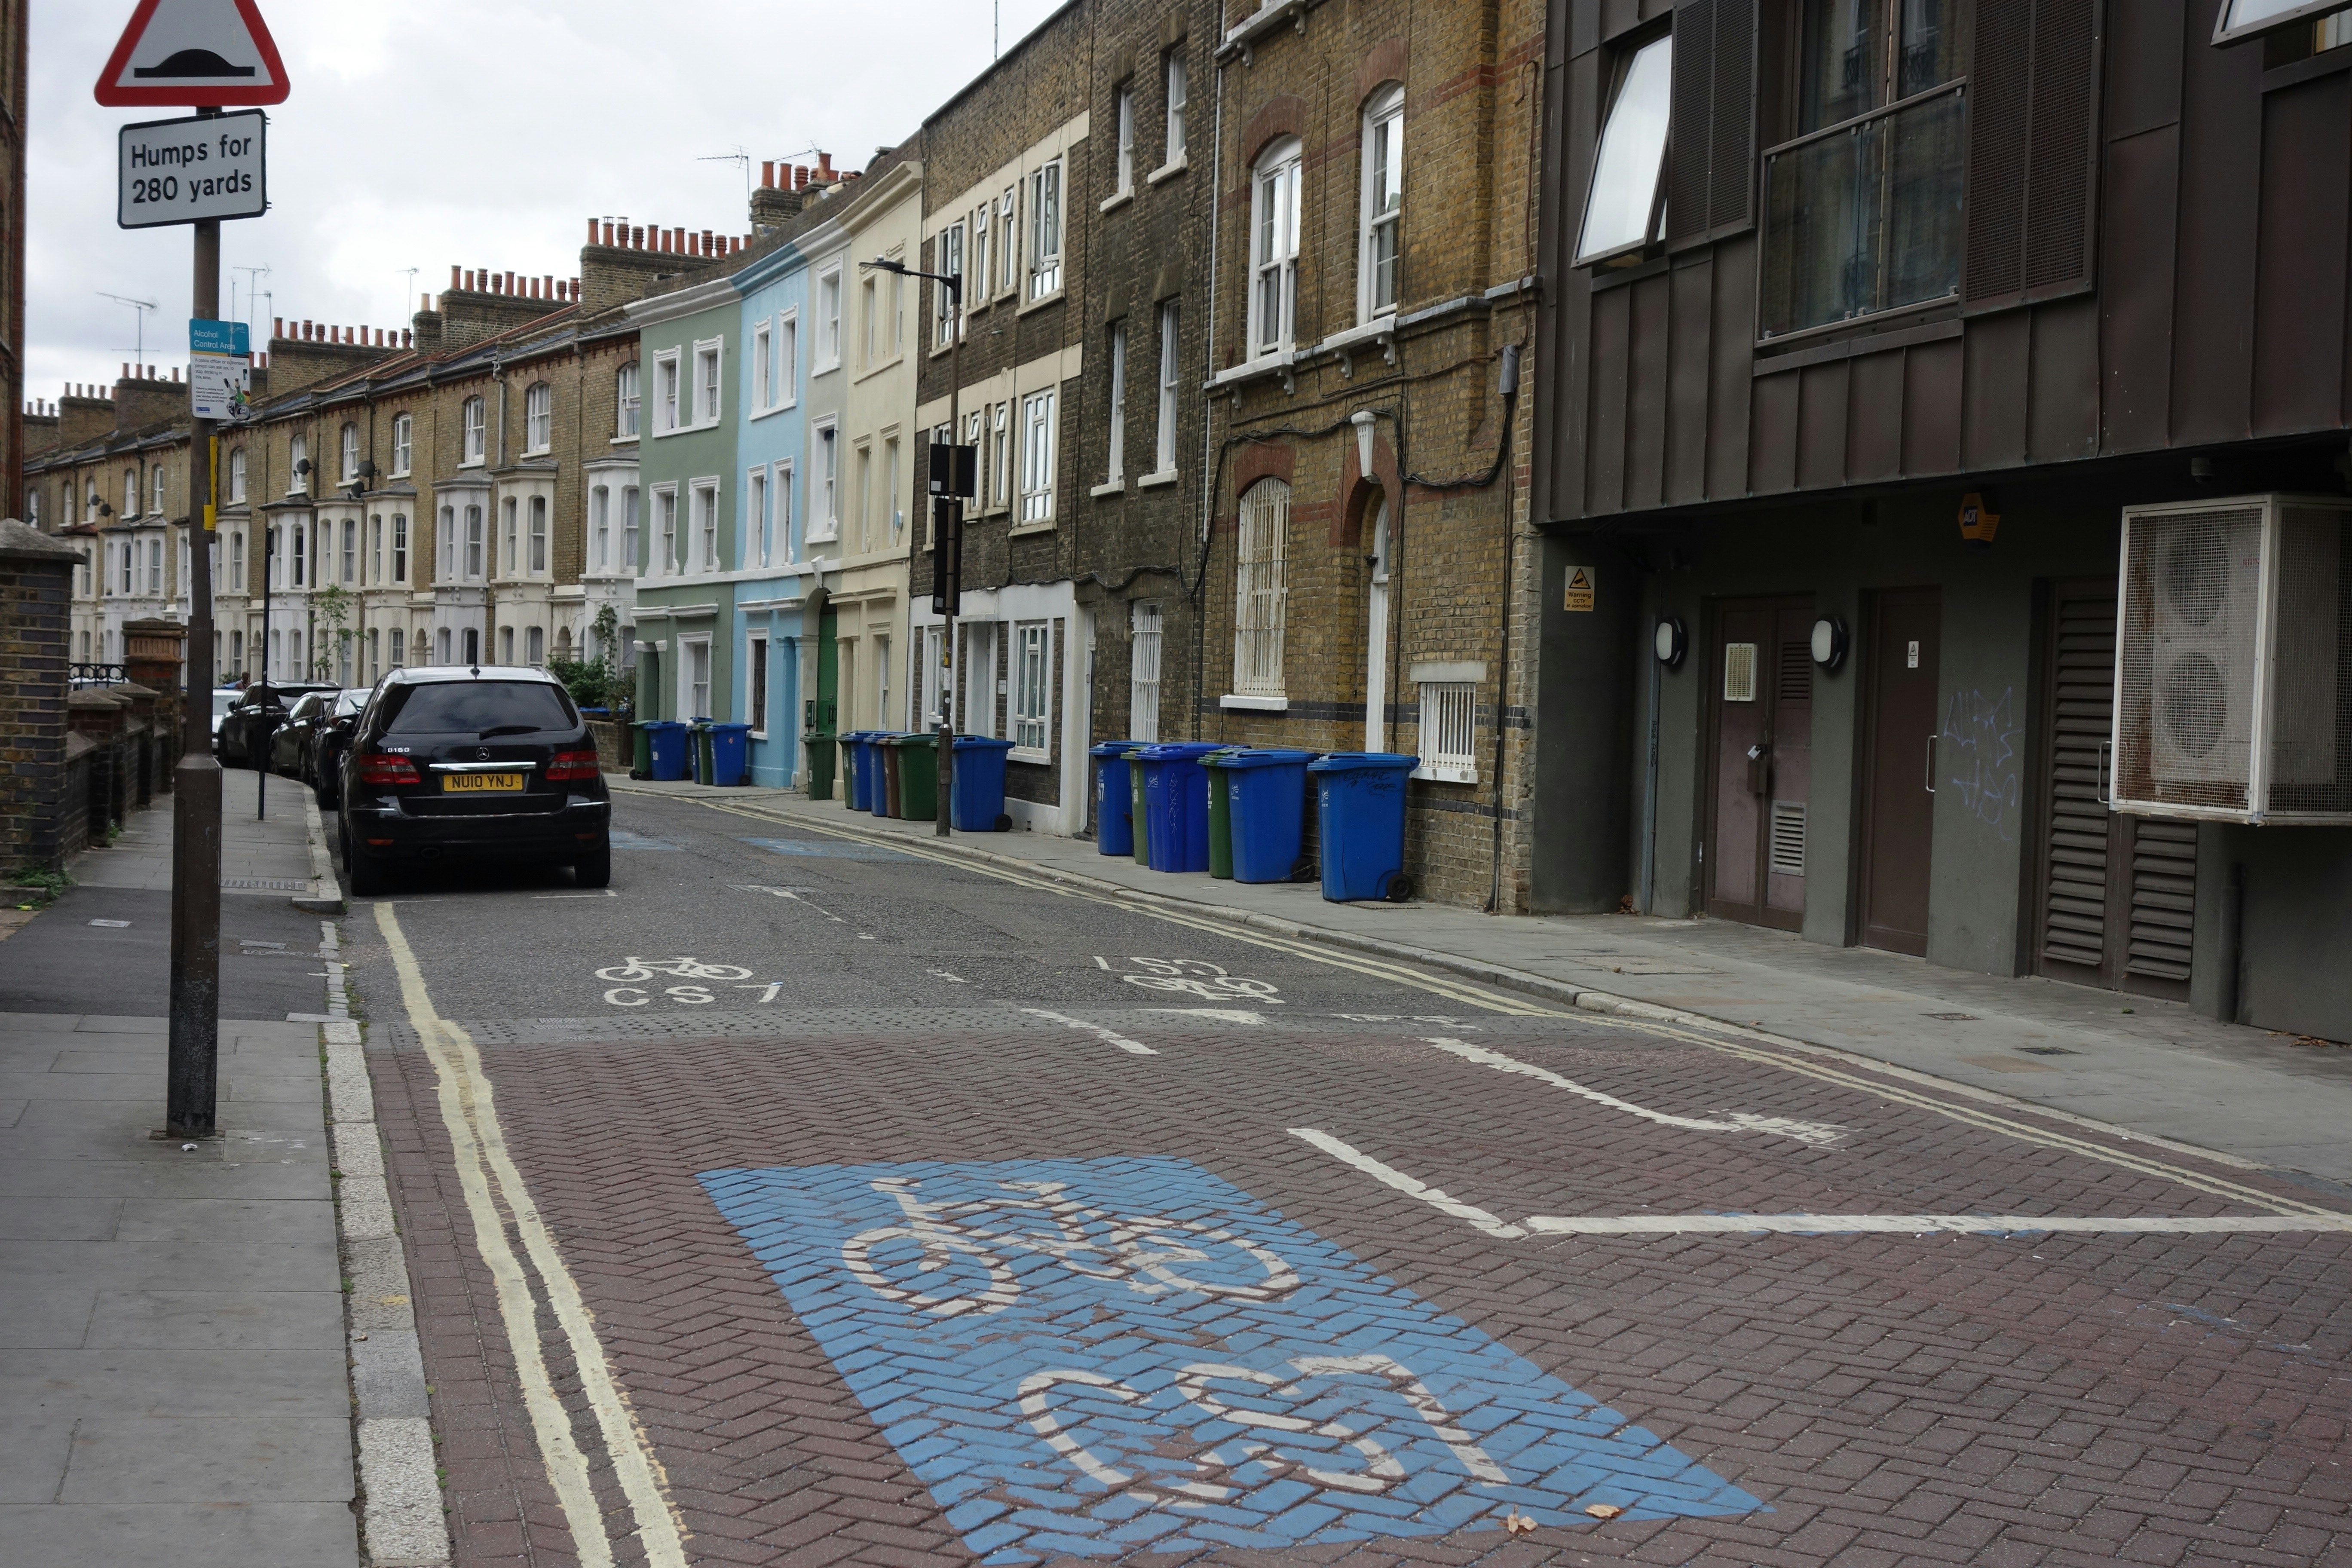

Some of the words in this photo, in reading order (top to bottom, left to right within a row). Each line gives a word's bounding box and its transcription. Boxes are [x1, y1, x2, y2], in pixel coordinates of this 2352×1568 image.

[132, 143, 207, 168] Humps
[219, 134, 251, 158] for
[132, 176, 178, 204] 280
[189, 169, 251, 202] yards
[193, 329, 218, 338] Alcohol
[194, 340, 218, 348] Control
[220, 342, 236, 350] Area
[1964, 509, 1977, 523] ADT
[452, 775, 482, 788] NU10
[487, 775, 513, 787] YNJ
[1098, 782, 1105, 802] 67
